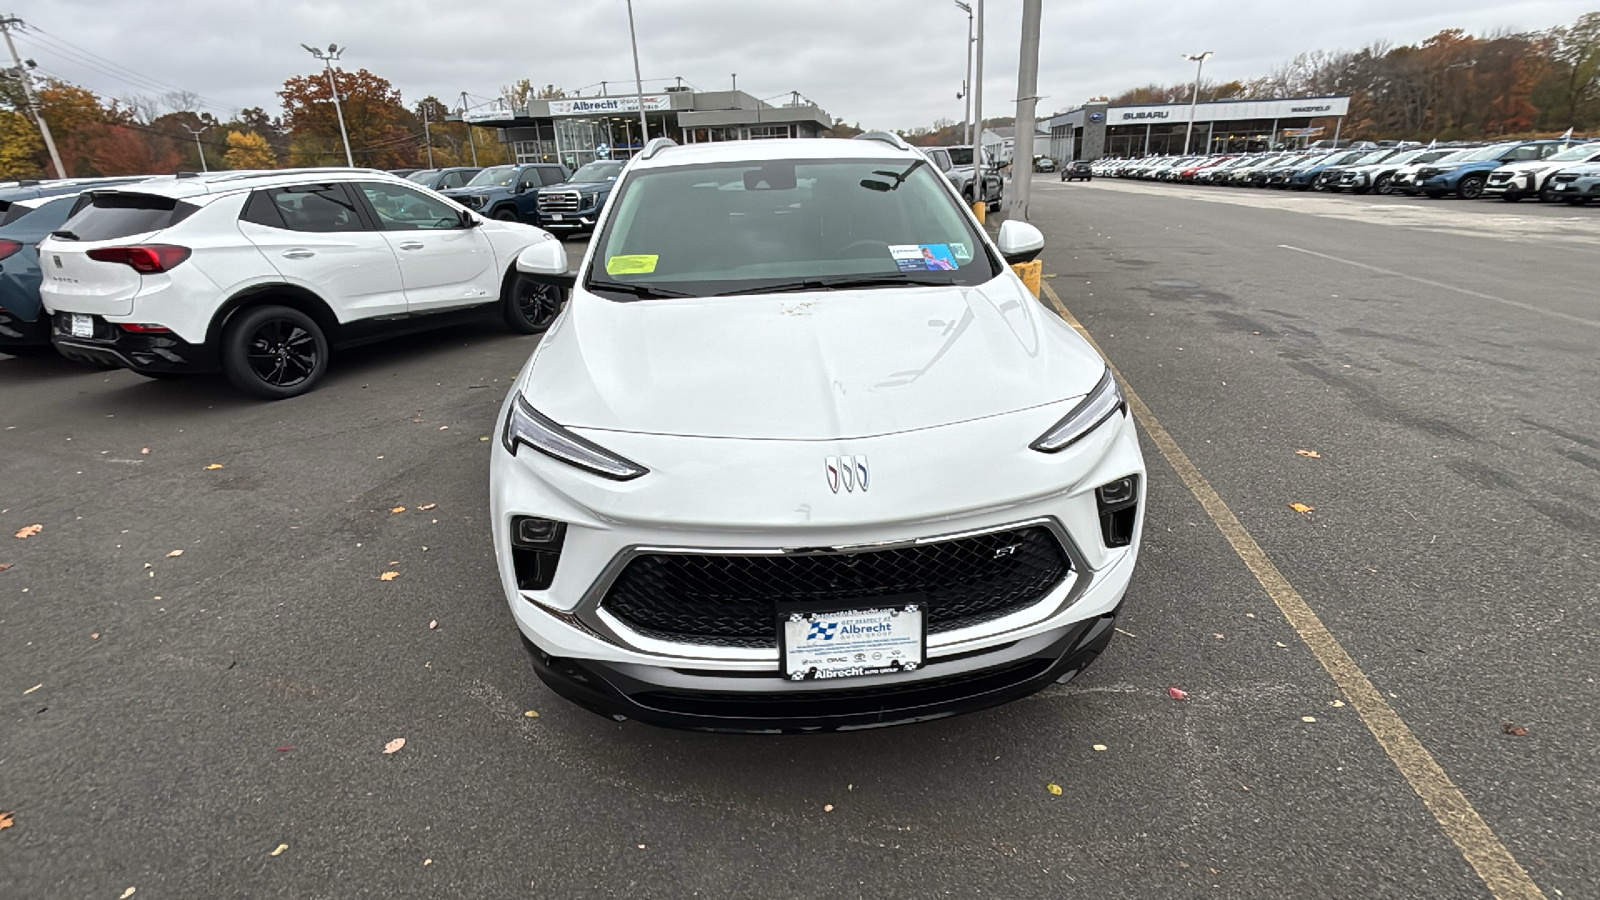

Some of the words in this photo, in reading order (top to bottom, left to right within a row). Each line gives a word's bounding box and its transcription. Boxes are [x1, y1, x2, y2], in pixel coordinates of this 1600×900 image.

[573, 100, 618, 111] Albrecht
[1123, 111, 1169, 120] SUBARU
[855, 617, 882, 625] RESPECT
[840, 623, 892, 634] Albrecht
[814, 667, 864, 679] Albrecht
